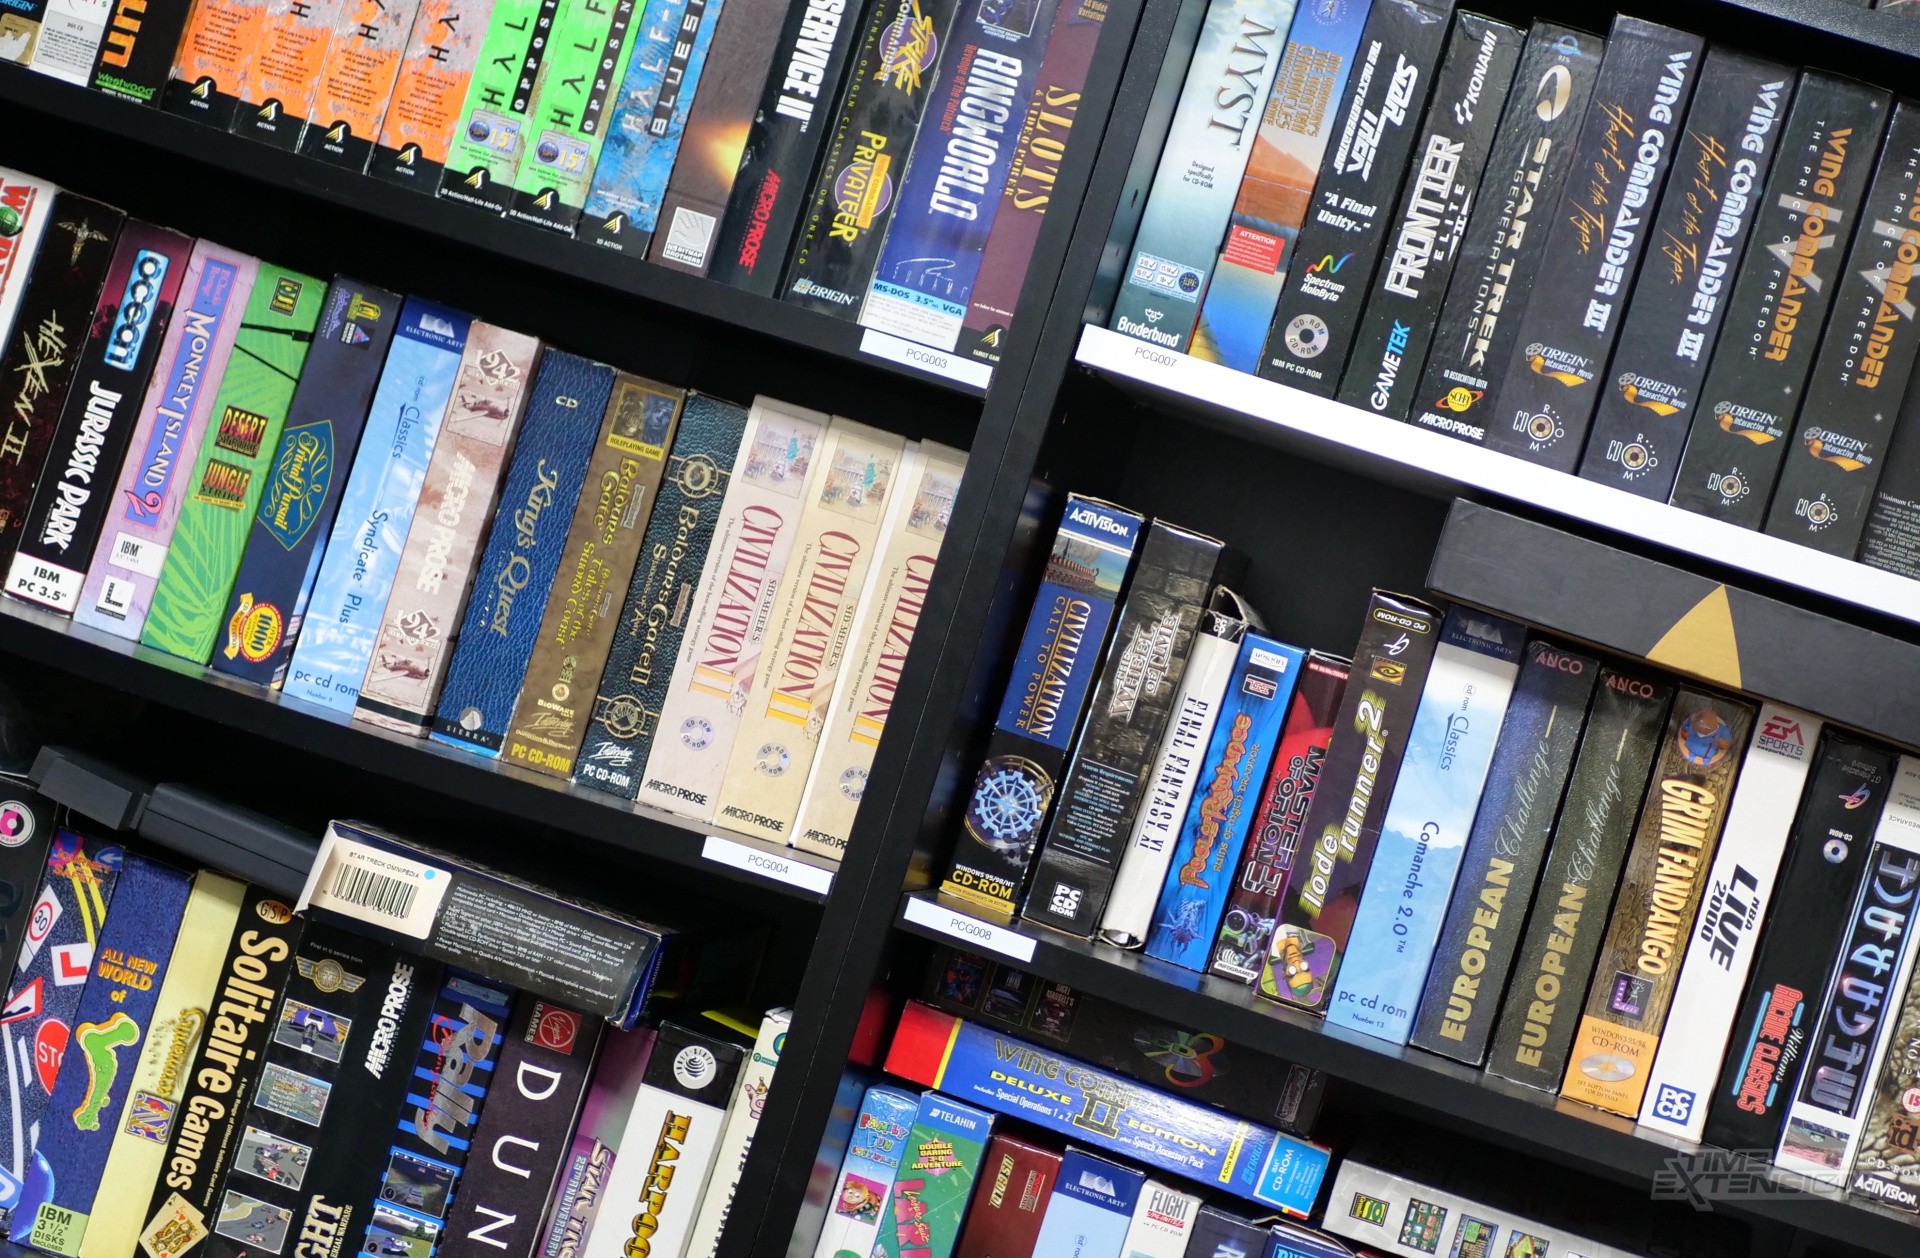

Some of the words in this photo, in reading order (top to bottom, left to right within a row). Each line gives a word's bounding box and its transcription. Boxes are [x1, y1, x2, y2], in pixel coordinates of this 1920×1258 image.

[784, 0, 846, 98] SERVICE
[96, 71, 156, 96] westwood
[847, 60, 867, 108] ORIGIN
[1208, 14, 1278, 152] MYST
[1466, 30, 1498, 107] KONAMI
[190, 99, 209, 110] ACTION
[1649, 50, 1693, 125] WING
[257, 121, 277, 132] ACTION
[929, 48, 1023, 221] RINGWORLD
[1023, 101, 1042, 145] VIDEO
[1742, 80, 1785, 155] WING
[324, 143, 344, 154] ACTION
[824, 116, 850, 181] CLASSICS
[1013, 85, 1081, 214] SLOTS
[1813, 127, 1853, 198] WING
[396, 165, 415, 176] ACTION
[1004, 148, 1026, 197] POKER
[1192, 160, 1216, 173] Designed
[1192, 178, 1214, 190] CD-ROM
[829, 131, 887, 244] PRIVATEER
[1506, 137, 1552, 250] STAR
[1789, 166, 1812, 222] PRICE
[806, 214, 818, 239] ONE
[1340, 198, 1378, 220] Final
[1384, 134, 1465, 299] FRONTIER
[1434, 184, 1466, 261] ELITE
[1594, 128, 1665, 297] COMMANDER
[1240, 230, 1277, 246] ATTENTION
[1468, 170, 1526, 332] GENERATIONS
[1687, 158, 1758, 327] COMMANDER
[808, 282, 857, 306] ORIGIN
[873, 283, 910, 299] MS-DOS
[943, 303, 963, 316] VGA
[1300, 284, 1340, 302] HoloByte
[1304, 273, 1345, 293] Spectrum
[1765, 202, 1829, 362] COMMANDER
[1469, 258, 1516, 372] TREK
[1583, 298, 1612, 333] III
[1749, 270, 1781, 356] FREEDOM
[1856, 229, 1920, 389] COMMANDER
[405, 325, 446, 345] ELECTRONIC
[446, 339, 464, 350] ARTS
[1117, 315, 1180, 348] Broderbund
[1676, 329, 1706, 362] III
[1841, 296, 1875, 384] FREEDOM
[173, 308, 217, 411] MONKEY
[906, 348, 948, 369] PCG003
[1135, 346, 1178, 369] PCG007
[1272, 358, 1285, 368] IBM
[1295, 365, 1322, 380] CD-ROM
[1371, 318, 1411, 411] GAMETEK
[1542, 346, 1590, 368] ORIGIN
[1545, 359, 1577, 375] Interactive
[555, 395, 579, 409] CD
[1635, 376, 1682, 398] ORIGIN
[64, 379, 123, 484] JURASSIC
[222, 411, 267, 442] DESERT
[1730, 403, 1779, 426] ORIGIN
[144, 404, 184, 488] ISLAND
[392, 406, 420, 459] Classics
[610, 437, 645, 453] ROLEPLAYING
[1820, 430, 1868, 452] ORIGIN
[203, 462, 250, 494] JUNGLE
[43, 481, 91, 551] PARK
[514, 458, 559, 550] King's
[1069, 509, 1130, 537] ACTIVISION
[121, 539, 141, 557] IBM
[352, 509, 388, 581] Syndicate
[18, 579, 36, 593] PC
[33, 565, 60, 584] IBM
[701, 504, 785, 676] CIVILIZATION
[339, 593, 362, 624] Plus
[490, 552, 531, 637] Quest
[752, 598, 773, 643] MEIER'S
[776, 530, 861, 698] CIVILIZATION
[1045, 596, 1067, 634] CALL
[250, 612, 274, 652] 1000
[642, 604, 669, 673] Gate
[829, 624, 849, 668] MEIER'S
[1029, 600, 1091, 740] CIVILIZATION
[1535, 651, 1583, 676] ANCO
[294, 669, 311, 684] pc
[315, 671, 331, 688] cd
[335, 682, 359, 698] rom
[1015, 672, 1042, 728] POWER
[1605, 674, 1654, 699] ANCO
[446, 725, 487, 743] SIERRA
[1440, 716, 1470, 772] Classics
[1758, 735, 1804, 756] SPORTS
[511, 743, 527, 759] PC
[528, 748, 571, 772] CD-ROM
[583, 763, 596, 778] PC
[596, 767, 631, 787] CD-ROM
[1274, 745, 1326, 871] MASTER
[1340, 736, 1384, 854] runner
[1493, 740, 1550, 858] Challenge
[1256, 777, 1297, 867] ORION
[1661, 778, 1716, 850] GRIM
[364, 855, 387, 870] TRECK
[386, 862, 419, 878] OMNIPEDIA
[747, 854, 789, 875] PCG004
[955, 864, 985, 879] WINDOWS
[1304, 833, 1340, 909] lode
[1403, 821, 1440, 900] Comanche
[952, 870, 1012, 900] CD-ROM
[1055, 884, 1081, 901] PC
[1050, 905, 1074, 918] ROM
[1638, 847, 1699, 975] FANDANGO
[1700, 879, 1728, 942] 2000
[1709, 863, 1760, 972] LIVE
[1745, 896, 1760, 931] NBA
[950, 918, 992, 941] PCG008
[101, 946, 124, 966] ALL
[128, 955, 158, 975] NEW
[1440, 857, 1515, 1042] EUROPEAN
[98, 960, 153, 992] WORLD
[1217, 960, 1256, 979] INFOGRAMES
[1515, 882, 1588, 1068] EUROPEAN
[1811, 851, 1920, 1111] MEGARACE
[110, 989, 127, 1004] of
[197, 929, 289, 1096] Solitaire
[1338, 989, 1356, 1003] pc
[1360, 994, 1379, 1011] cd
[1381, 1002, 1407, 1019] rom
[1758, 984, 1804, 1044] ARCADE
[524, 1003, 544, 1043] GAMES
[1591, 1025, 1628, 1043] WINDOWS
[995, 1038, 1062, 1080] WING
[1592, 1036, 1640, 1058] CD-ROM
[1775, 1027, 1805, 1083] Williams
[1737, 1040, 1781, 1115] CLASSICS
[989, 1070, 1073, 1106] DELUXE
[1128, 1118, 1218, 1157] EDITION
[995, 1088, 1018, 1105] Special
[1019, 1096, 1053, 1117] Operations
[1657, 1100, 1688, 1122] CD
[1660, 1087, 1691, 1108] PC
[939, 1109, 977, 1131] TELAHIN
[166, 1094, 227, 1192] Games
[1132, 1135, 1156, 1153] Speech
[1156, 1143, 1188, 1165] Accessory
[1188, 1155, 1206, 1170] Pack
[911, 1160, 963, 1171] ADVENTURE
[1271, 1148, 1295, 1192] CD-ROM
[1065, 1182, 1101, 1200] ELECTRONIC
[1150, 1189, 1192, 1218] FLIGHT
[1854, 1173, 1918, 1206] ACTIVISION
[39, 1205, 73, 1226] IBM
[337, 1205, 353, 1237] WARFARE
[32, 1238, 63, 1252] ENCLOSED
[33, 1231, 66, 1247] DISKS
